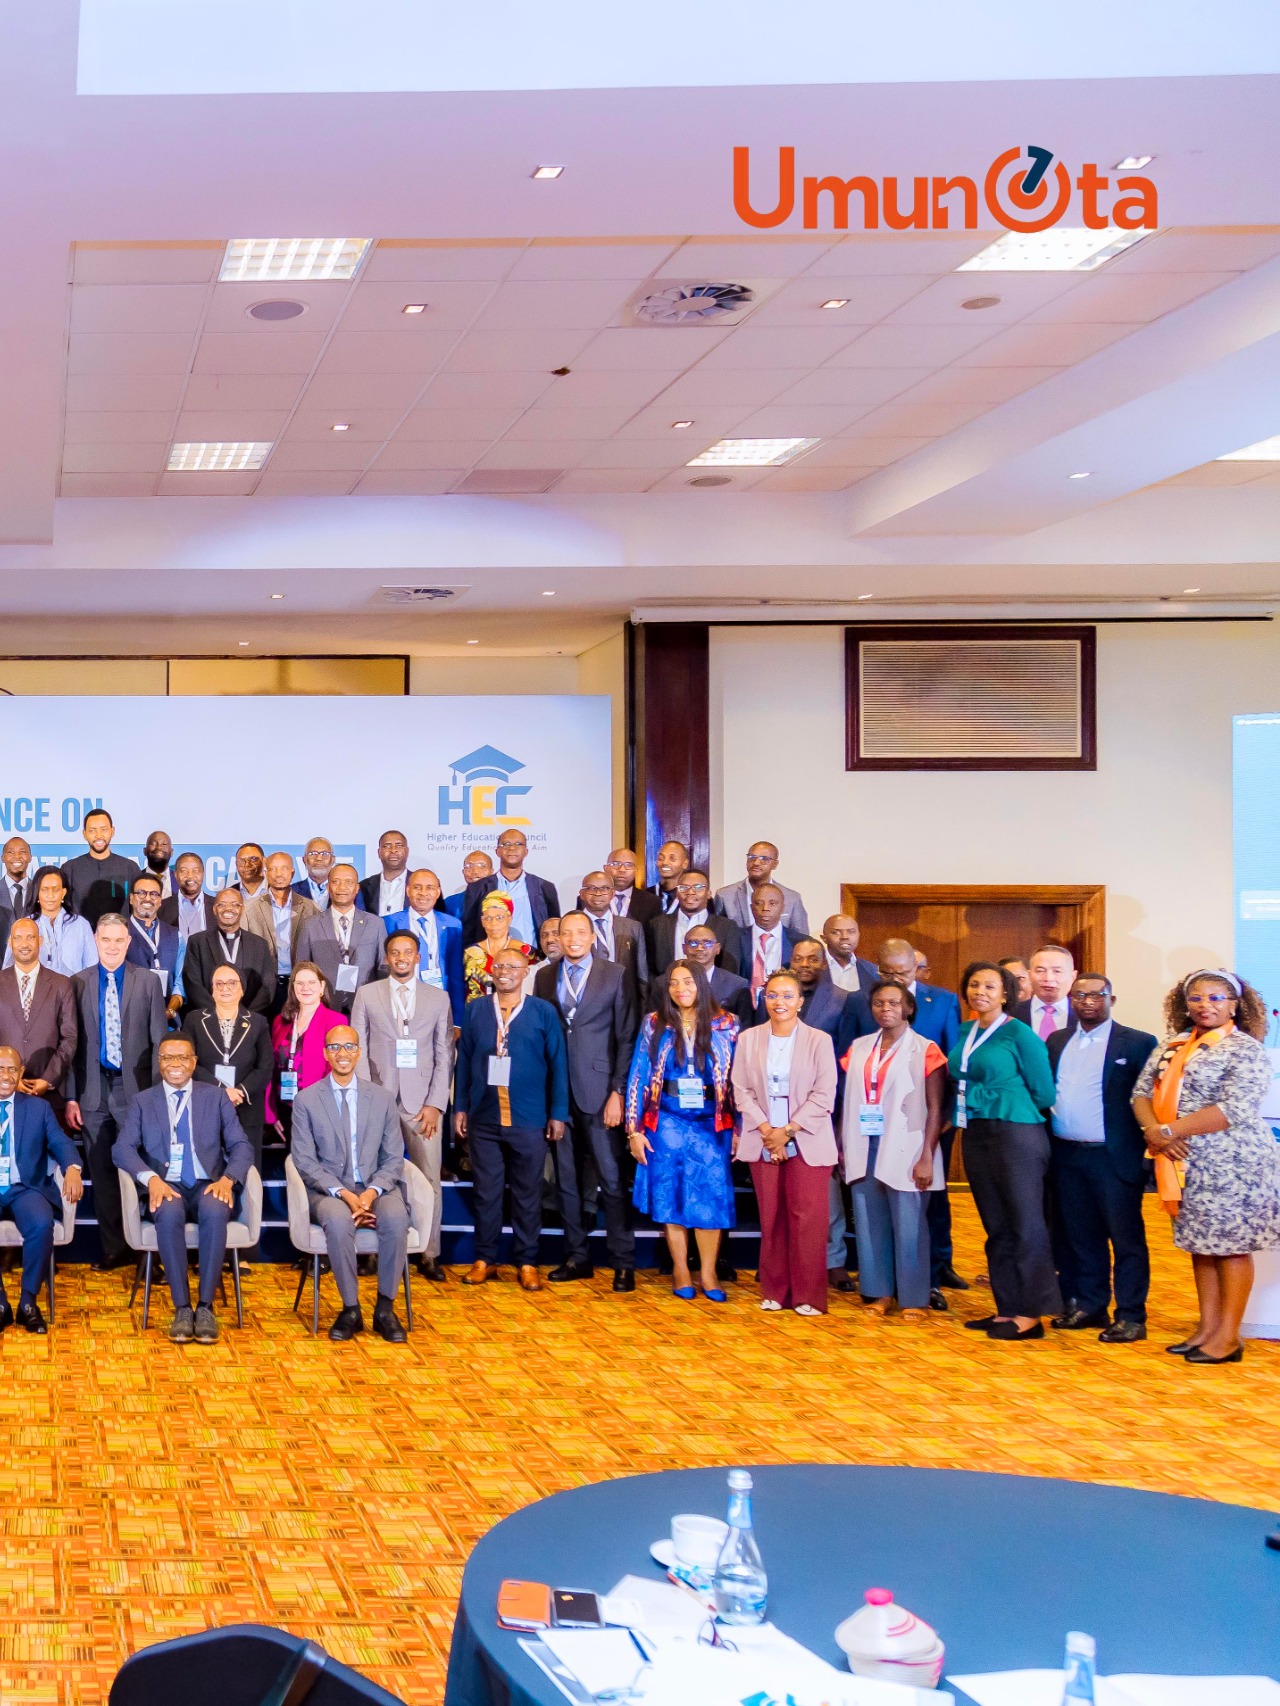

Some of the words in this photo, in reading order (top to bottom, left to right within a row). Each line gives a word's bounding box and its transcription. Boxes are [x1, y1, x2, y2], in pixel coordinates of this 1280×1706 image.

[438, 785, 535, 825] HEC
[427, 832, 458, 843] Higher
[461, 832, 500, 842] Educatio
